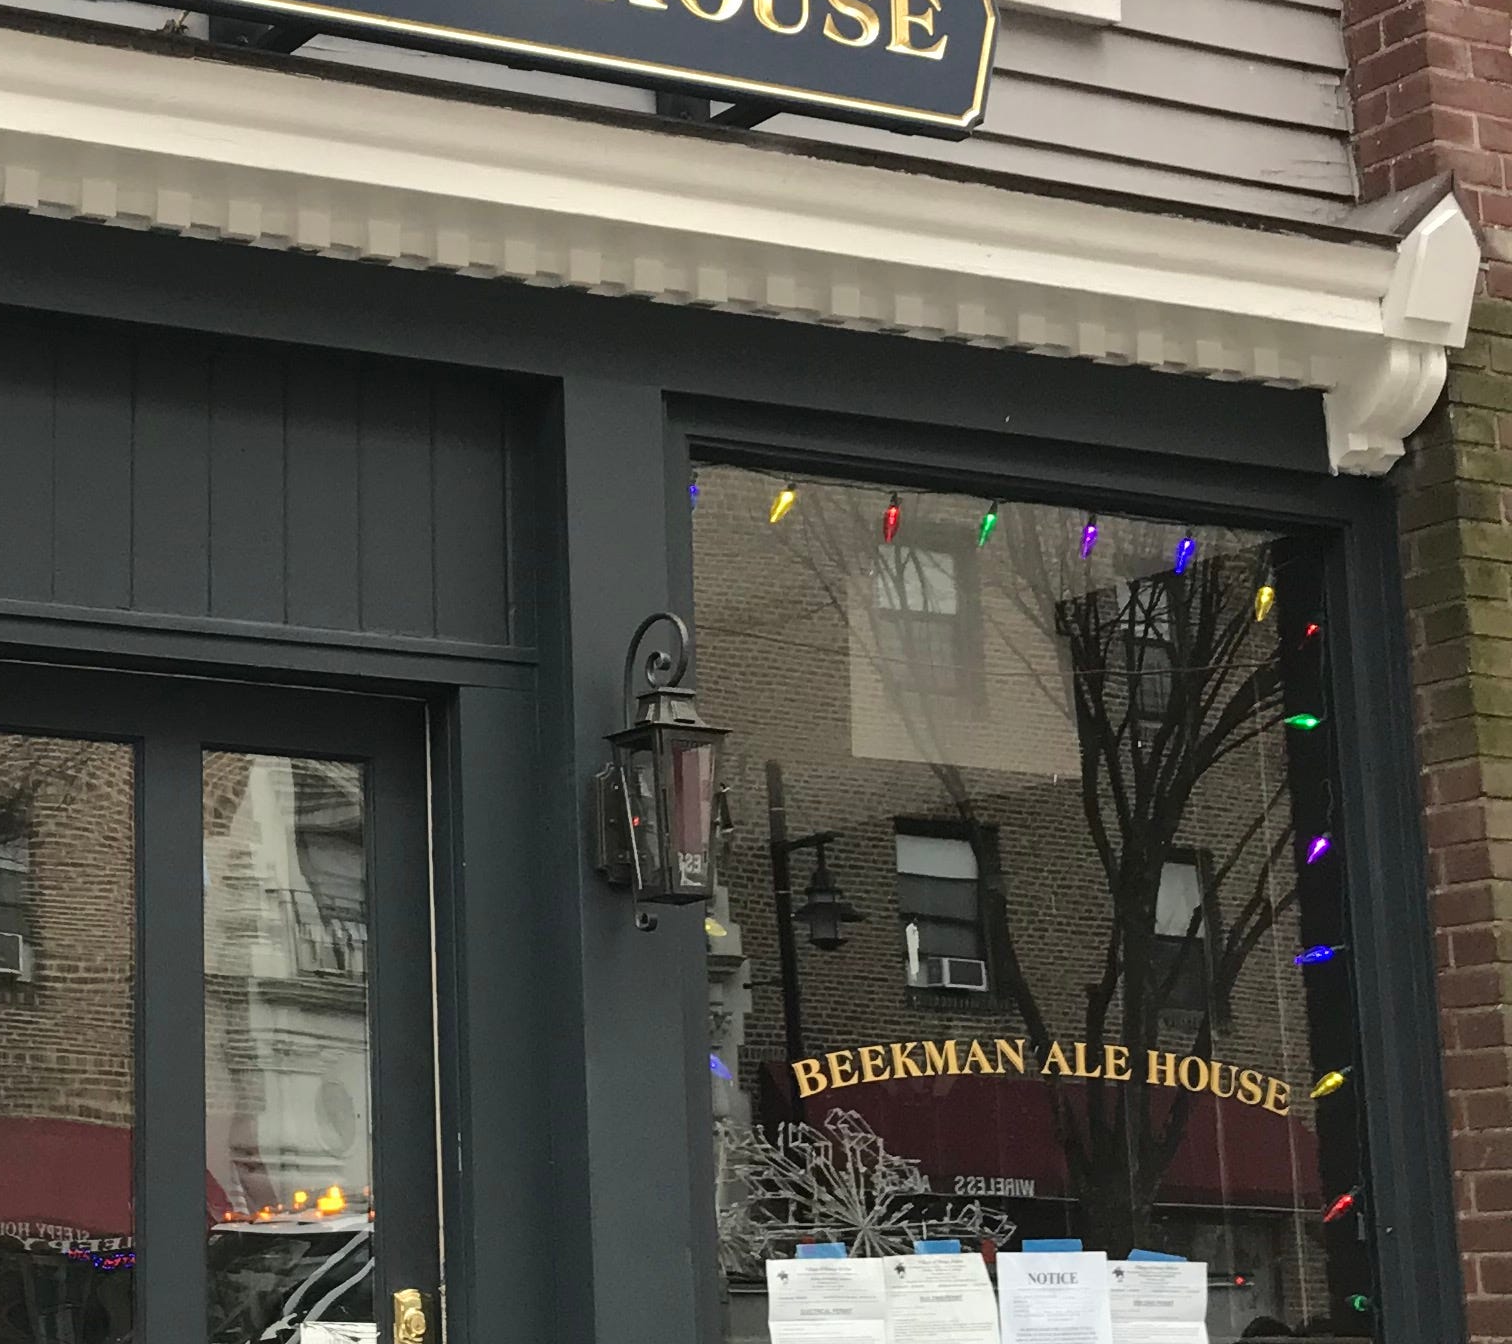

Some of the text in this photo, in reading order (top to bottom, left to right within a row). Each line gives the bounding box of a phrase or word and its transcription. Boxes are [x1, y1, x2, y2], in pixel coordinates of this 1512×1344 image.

[791, 1038, 1291, 1116] BEEKMAN ALE HOUSE
[1028, 1271, 1079, 1285] NOTICE
